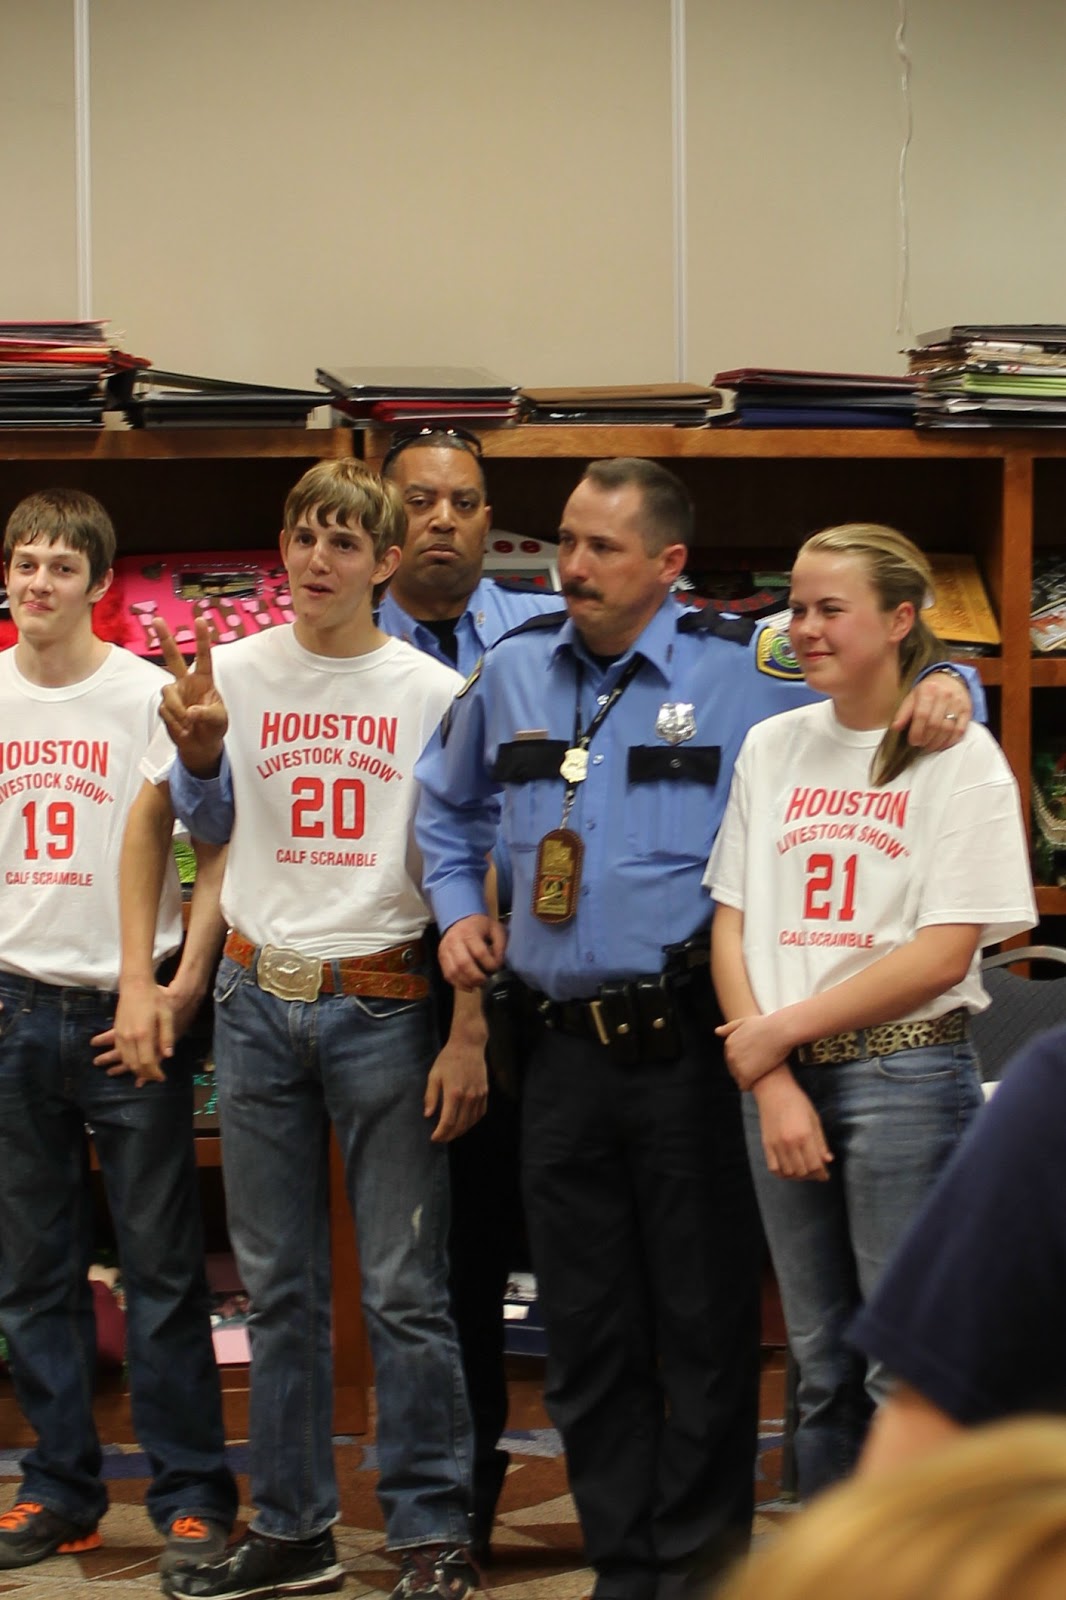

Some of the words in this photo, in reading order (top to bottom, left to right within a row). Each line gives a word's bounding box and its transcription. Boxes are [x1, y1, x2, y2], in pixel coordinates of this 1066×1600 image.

[261, 712, 398, 755] HOUSTON
[0, 740, 109, 778] OUSTON
[256, 747, 344, 780] LIVESTOCK
[291, 776, 365, 840] 20
[784, 787, 911, 830] HOUSTON
[22, 801, 75, 860] 19
[776, 823, 860, 856] LIVESTOCK
[276, 849, 307, 864] CALF
[310, 851, 378, 867] SCRAMBLE
[32, 872, 94, 887] SCRAMBLE
[802, 853, 859, 922] 21
[807, 932, 876, 949] SCRAMBLE
